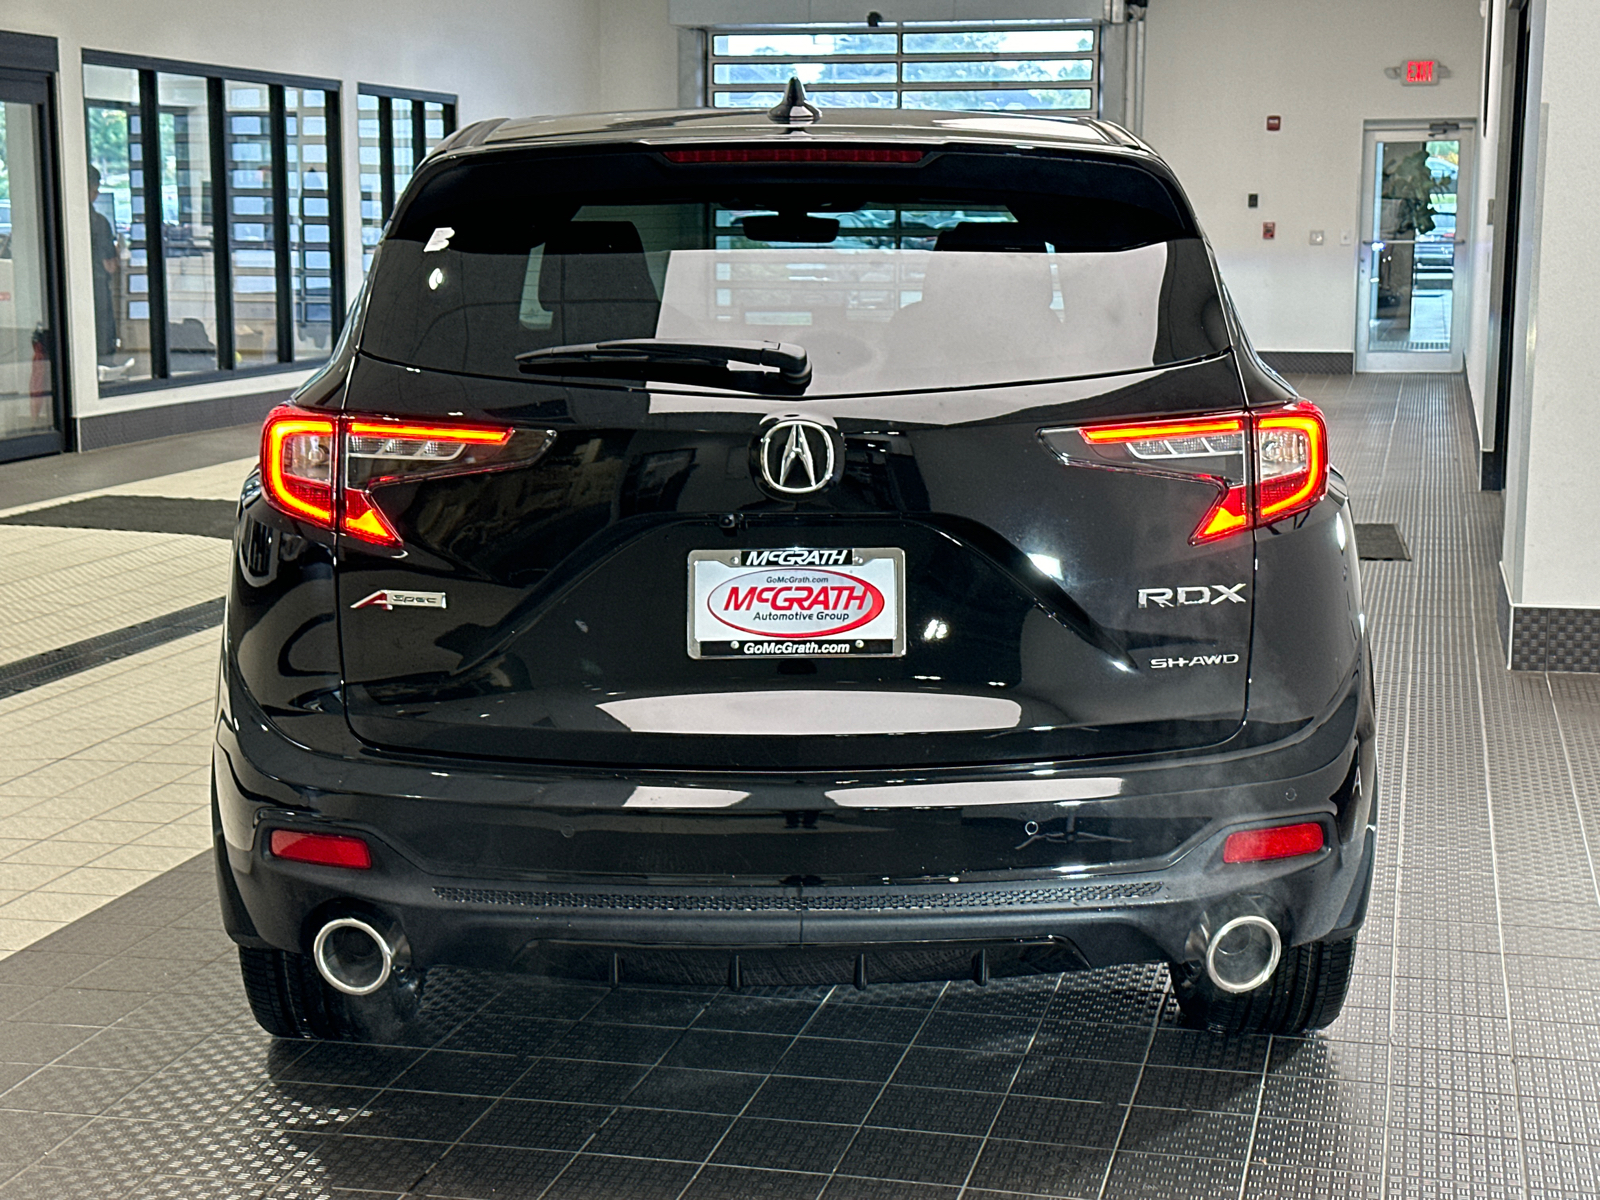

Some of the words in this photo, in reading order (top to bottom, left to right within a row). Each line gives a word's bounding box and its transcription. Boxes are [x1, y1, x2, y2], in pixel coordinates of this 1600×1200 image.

[1407, 61, 1434, 82] EXIT
[766, 576, 829, 584] GoMcGrath.com
[1138, 583, 1246, 608] RDX
[753, 611, 813, 621] Automotive
[816, 611, 850, 621] Group
[743, 642, 850, 654] GoMcGrath.com
[1150, 654, 1239, 669] SH-AWD
